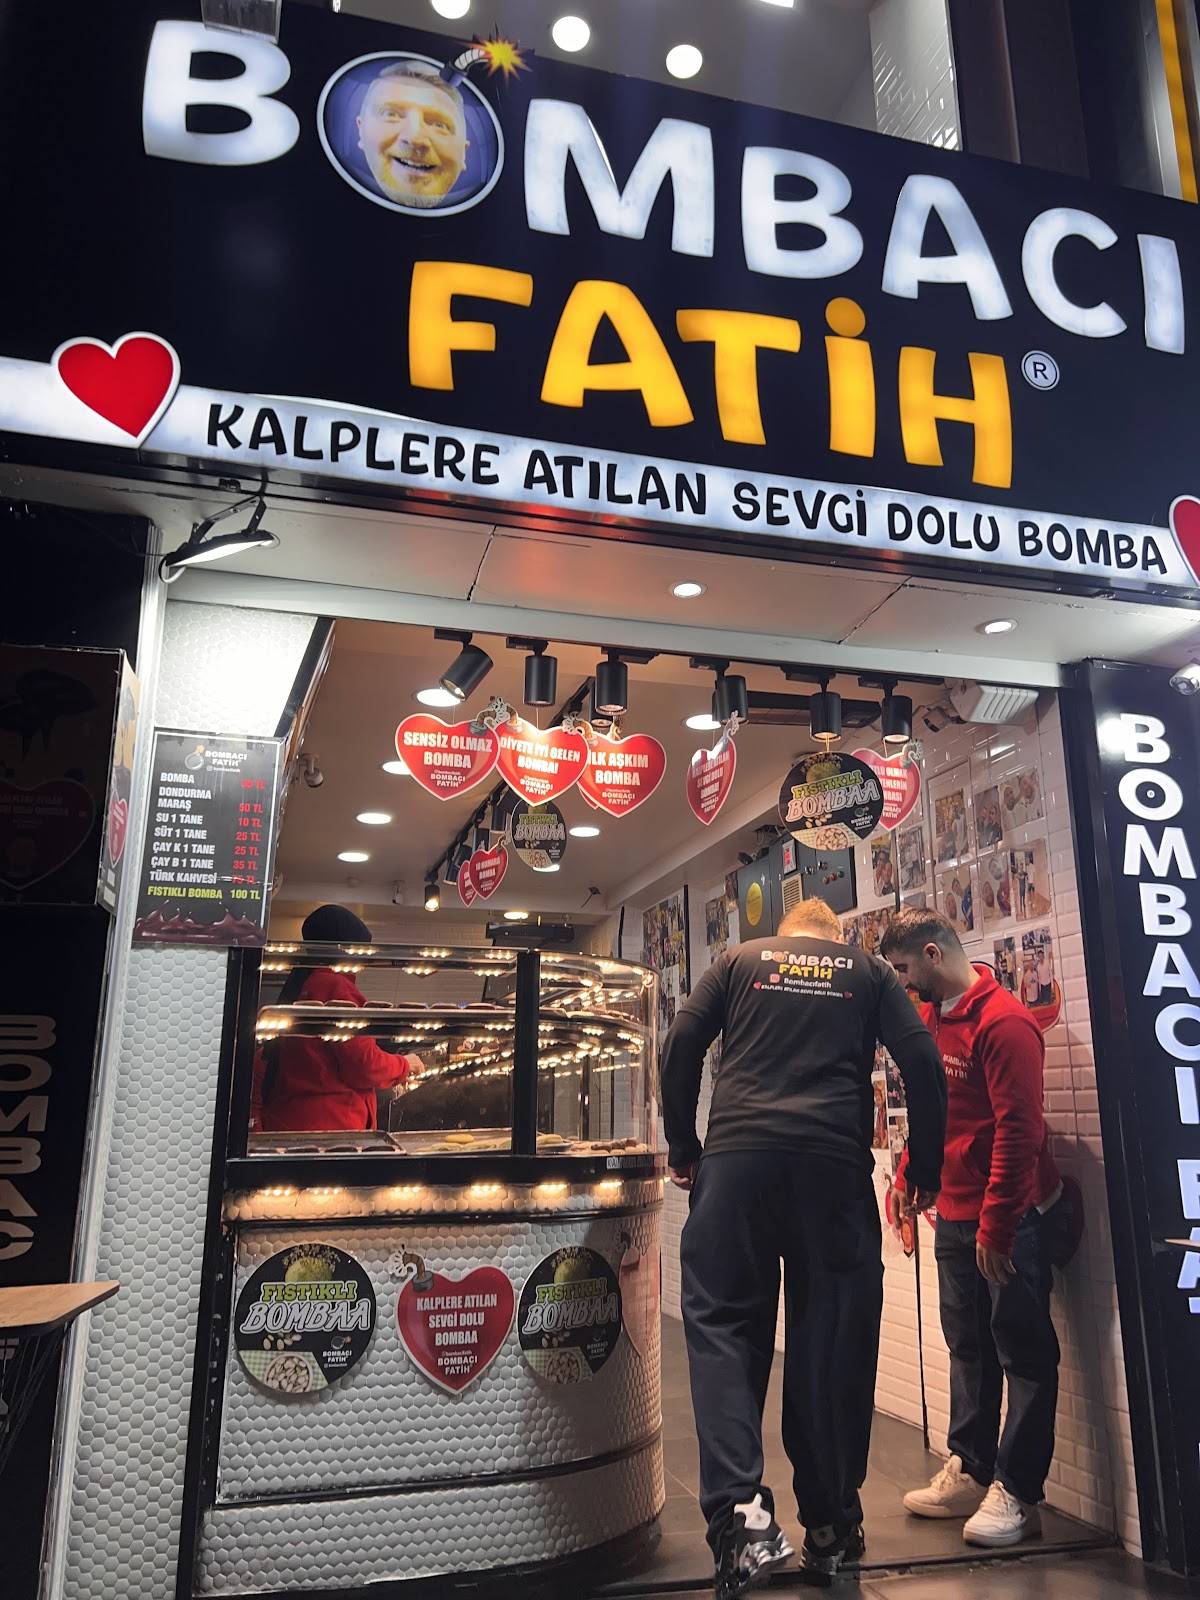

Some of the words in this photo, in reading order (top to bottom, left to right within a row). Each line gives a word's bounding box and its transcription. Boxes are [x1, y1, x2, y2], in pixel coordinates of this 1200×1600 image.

[207, 403, 499, 484] KALPLERE
[524, 449, 707, 515] ATILAN
[732, 481, 867, 536] SEVGİ
[887, 502, 1000, 552] DOLU
[1018, 520, 1167, 575] BOMBA
[403, 731, 449, 749] SENSİZ
[450, 735, 493, 753] OLMAZ
[423, 751, 472, 768] BOMBA
[608, 751, 649, 769] AŞKIM
[160, 772, 195, 784] BOMBA
[595, 769, 641, 786] BOMBA
[792, 770, 863, 799] FISTIKLI
[159, 786, 212, 800] DONDURMA
[785, 779, 880, 822] BOMBAA
[158, 798, 192, 811] MARAŞ
[156, 812, 169, 822] SU
[170, 813, 177, 823] 1
[179, 814, 204, 825] TANE
[251, 818, 262, 828] TL
[154, 825, 174, 837] SÜT
[175, 828, 181, 838] 1
[183, 829, 208, 840] TANE
[250, 832, 261, 842] TL
[152, 841, 172, 854] ÇAY
[173, 843, 181, 852] K
[182, 844, 189, 853] 1
[191, 844, 216, 855] TANE
[248, 847, 259, 856] TL
[151, 856, 171, 868] ÇAY
[181, 858, 187, 868] 1
[190, 858, 214, 869] TANE
[248, 860, 258, 870] TL
[149, 869, 175, 882] TÜRK
[176, 872, 217, 884] KAHVESİ
[147, 885, 187, 898] FISTIKLI
[187, 888, 223, 900] BOMBA
[230, 889, 248, 899] 100
[250, 890, 261, 900] TL
[262, 1282, 357, 1302] FISTIKLI
[537, 1278, 607, 1304] FISTIKLI
[416, 1295, 463, 1311] KALPLERE
[464, 1293, 497, 1309] ATILAN
[240, 1299, 371, 1333] BOMBAA
[428, 1310, 458, 1329] SEVGİ
[459, 1311, 485, 1326] DOLU
[522, 1292, 619, 1334] BOMBAA
[435, 1330, 478, 1346] BOMBAA
